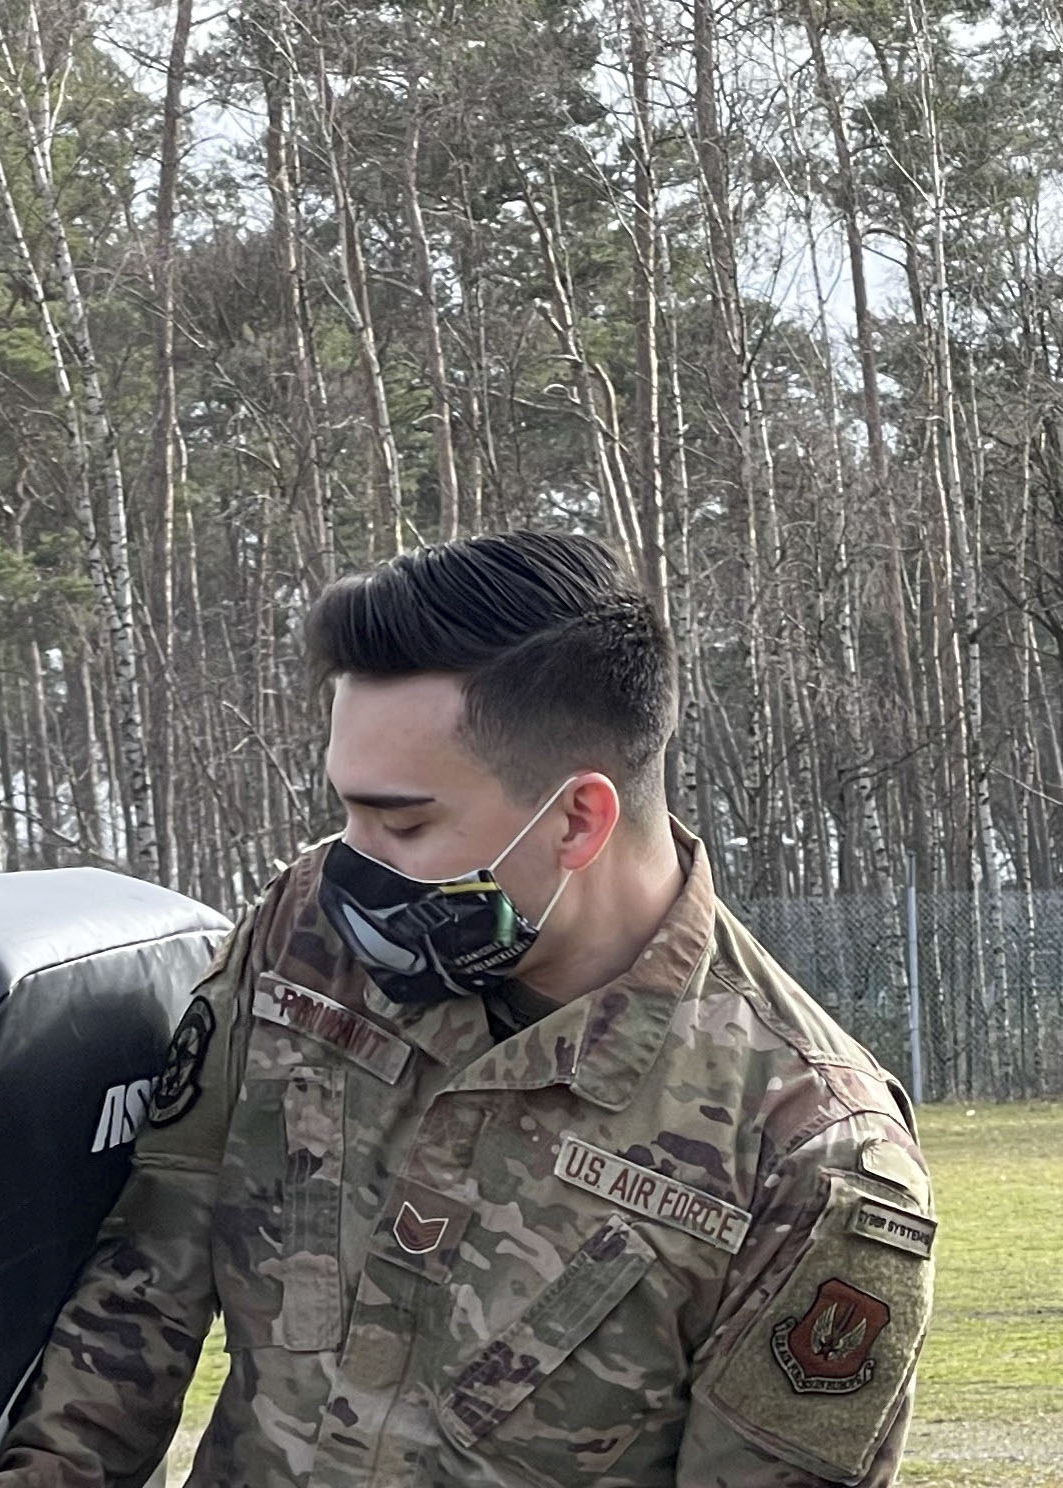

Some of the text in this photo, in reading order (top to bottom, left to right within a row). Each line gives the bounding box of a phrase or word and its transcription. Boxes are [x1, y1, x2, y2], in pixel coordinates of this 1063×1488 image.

[565, 1146, 736, 1244] U.S. AIR FORCE
